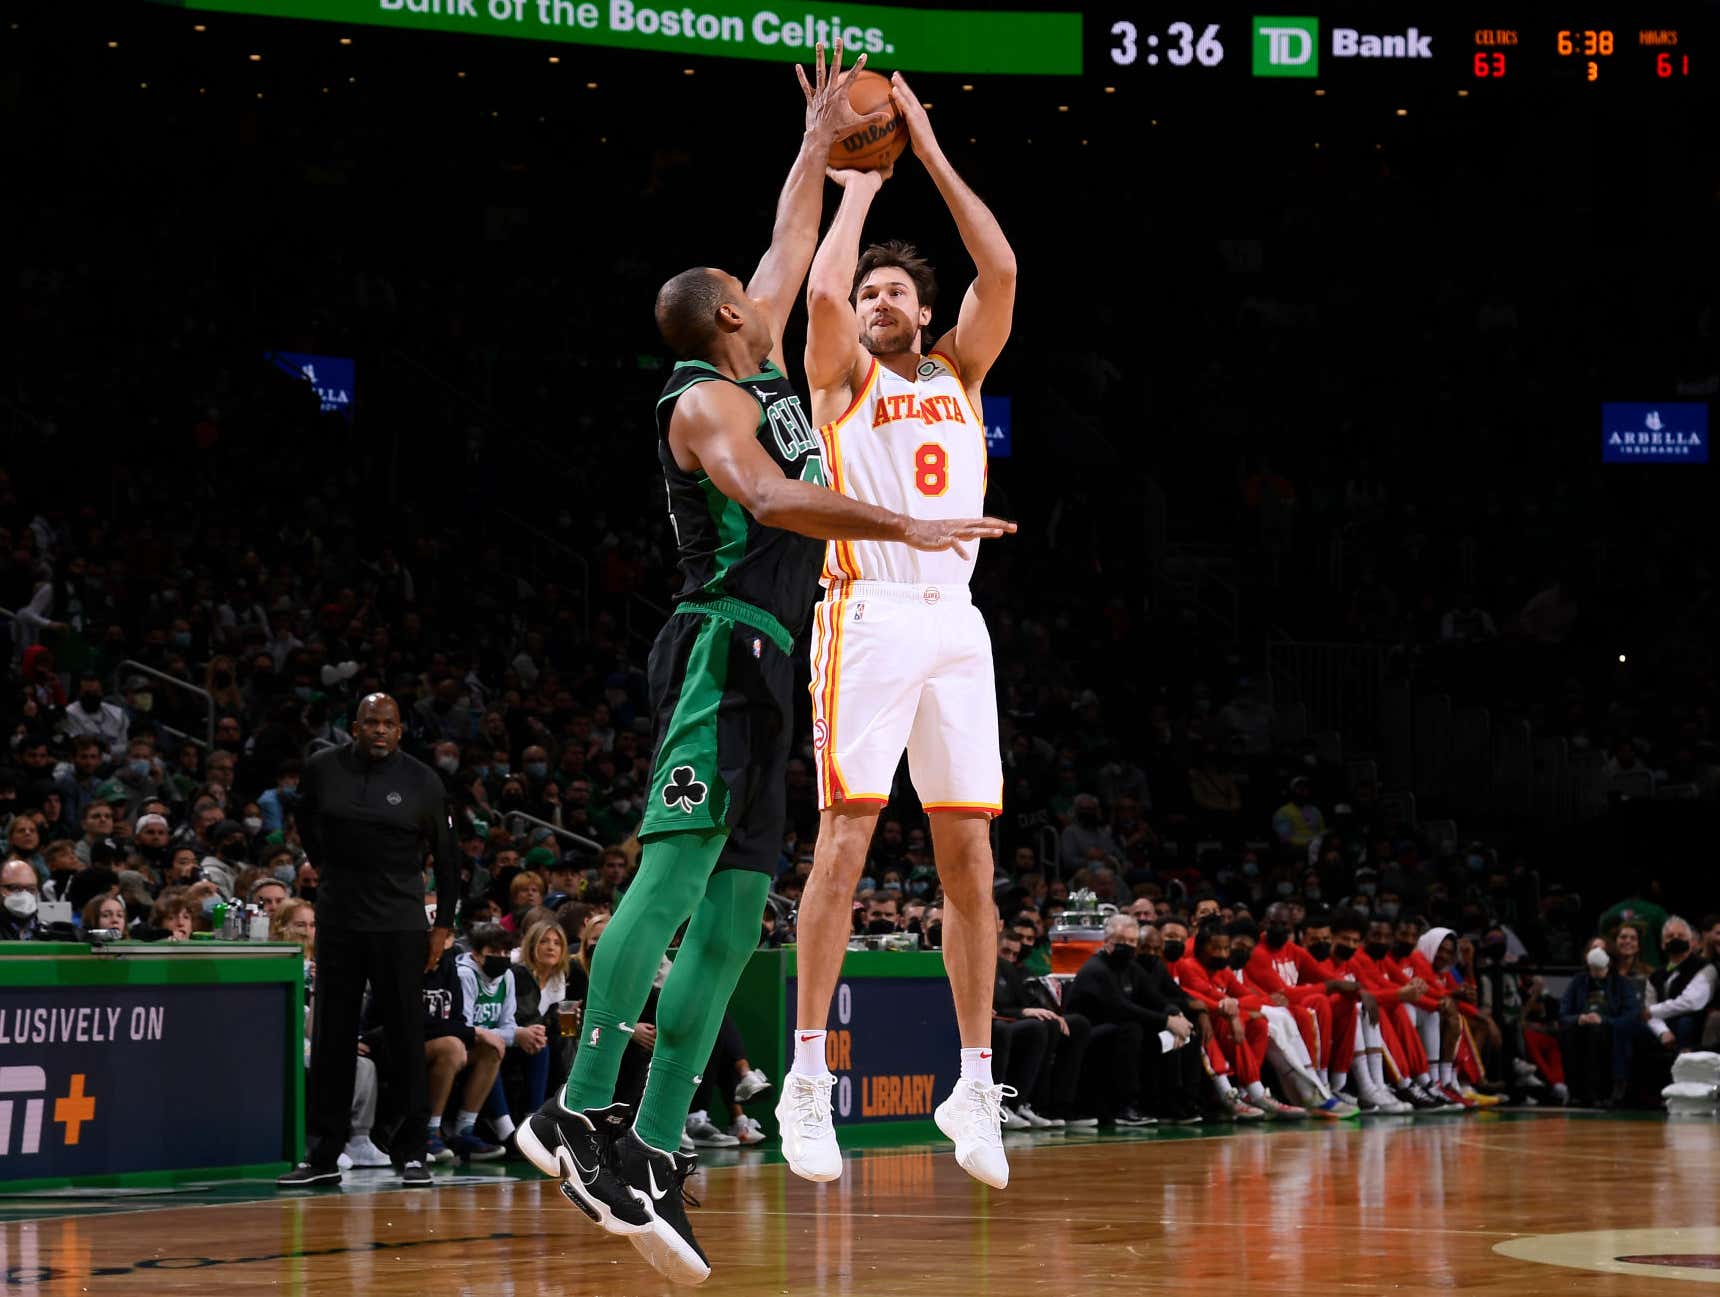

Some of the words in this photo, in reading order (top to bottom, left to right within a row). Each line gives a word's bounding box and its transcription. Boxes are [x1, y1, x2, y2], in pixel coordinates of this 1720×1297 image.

[488, 0, 527, 22] of
[537, 0, 599, 28] the
[609, 0, 744, 42] Boston
[752, 11, 895, 54] Celtics.
[1110, 21, 1224, 67] 3:36
[1475, 29, 1518, 45] CELTICS
[1557, 30, 1614, 56] 6:38
[1258, 27, 1313, 65] TD
[1332, 27, 1433, 58] Bank
[1474, 52, 1506, 78] 63
[1587, 61, 1598, 81] 3
[872, 394, 966, 429] ATLNTA
[1608, 431, 1702, 446] ARBELLA
[914, 441, 949, 497] 8
[130, 1006, 165, 1041] ON
[861, 1074, 936, 1118] LIBRARY
